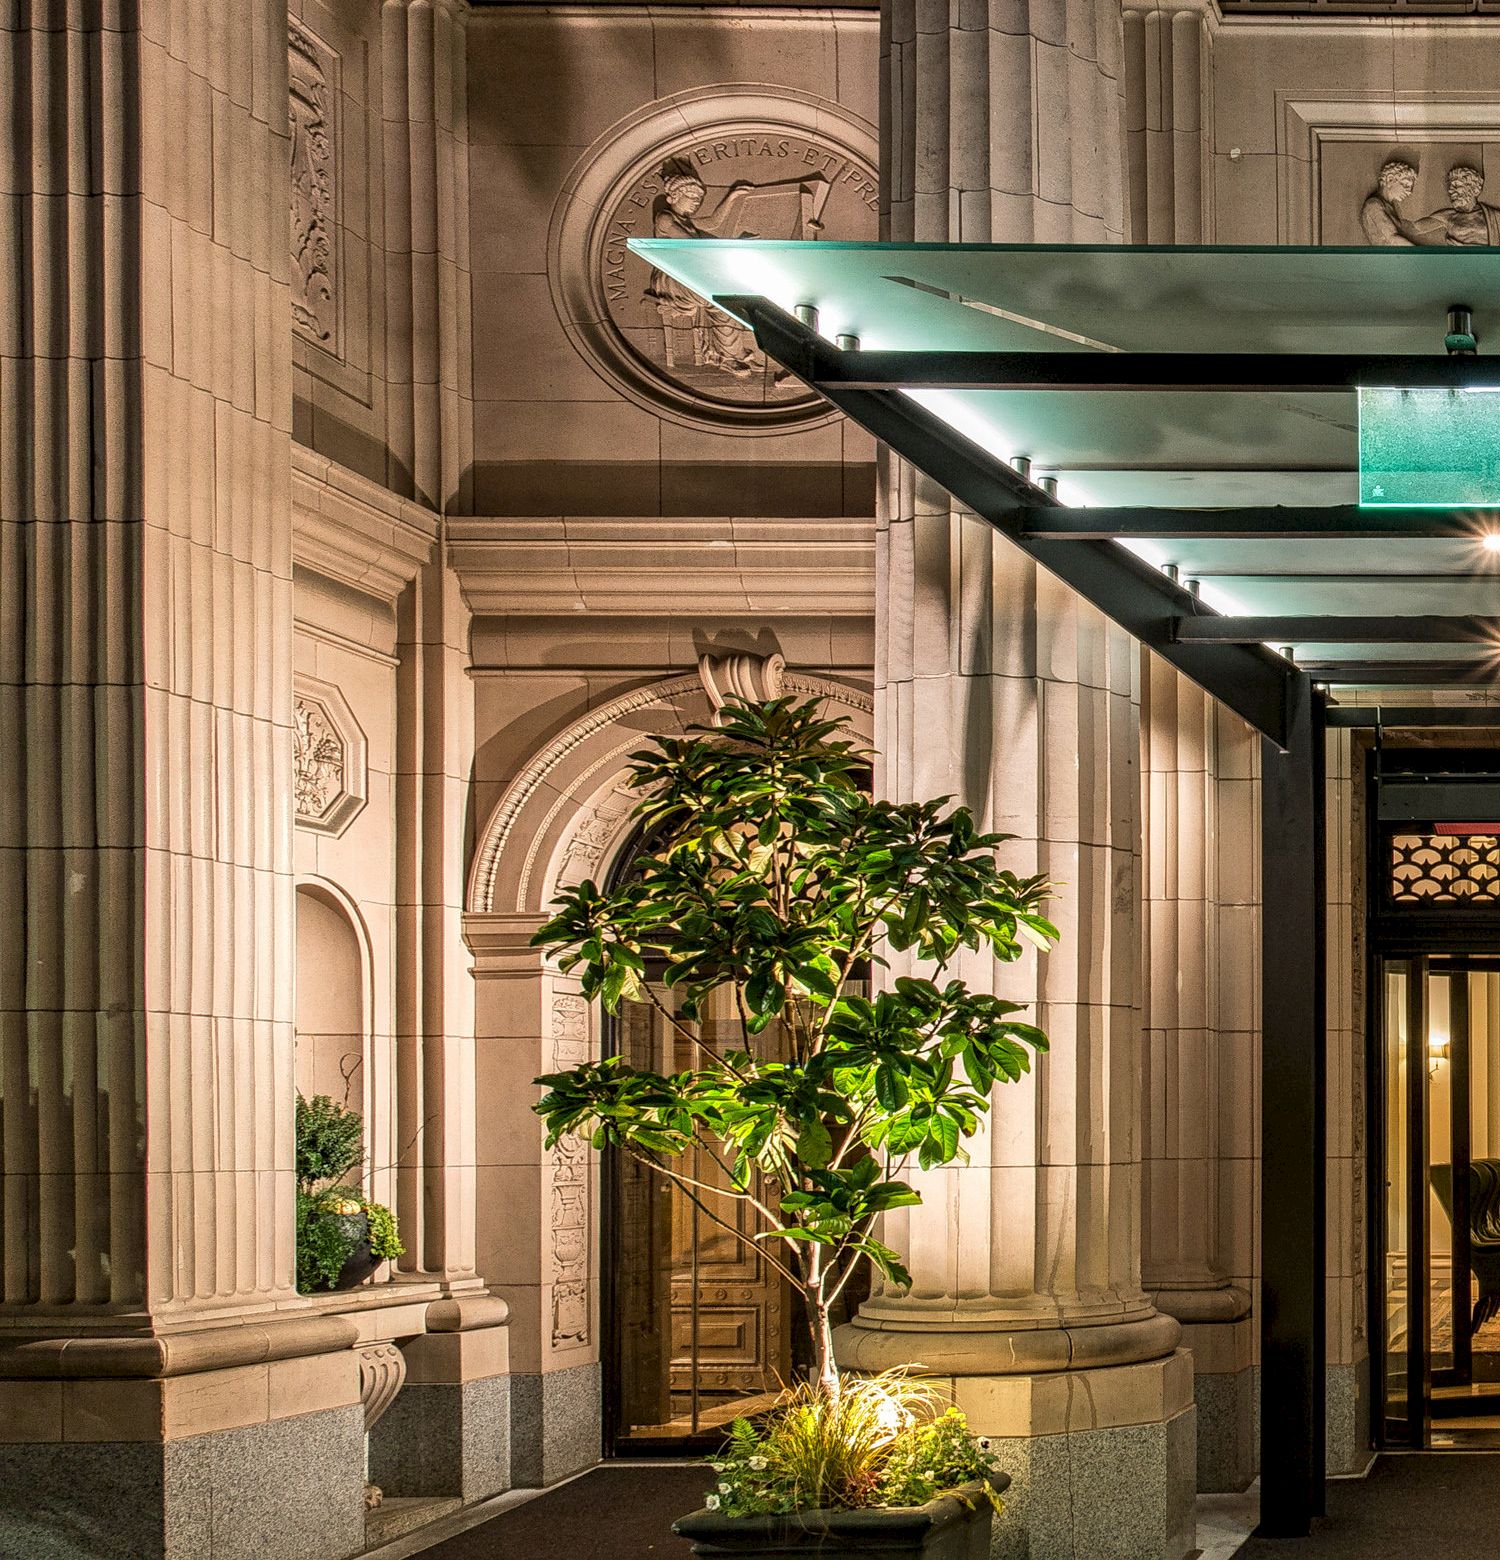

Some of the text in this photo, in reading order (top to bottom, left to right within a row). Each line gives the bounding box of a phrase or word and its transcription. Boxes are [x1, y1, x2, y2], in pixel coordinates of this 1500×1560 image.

[605, 219, 636, 302] MAGNA
[680, 138, 790, 168] VERITAS
[800, 146, 838, 172] ET
